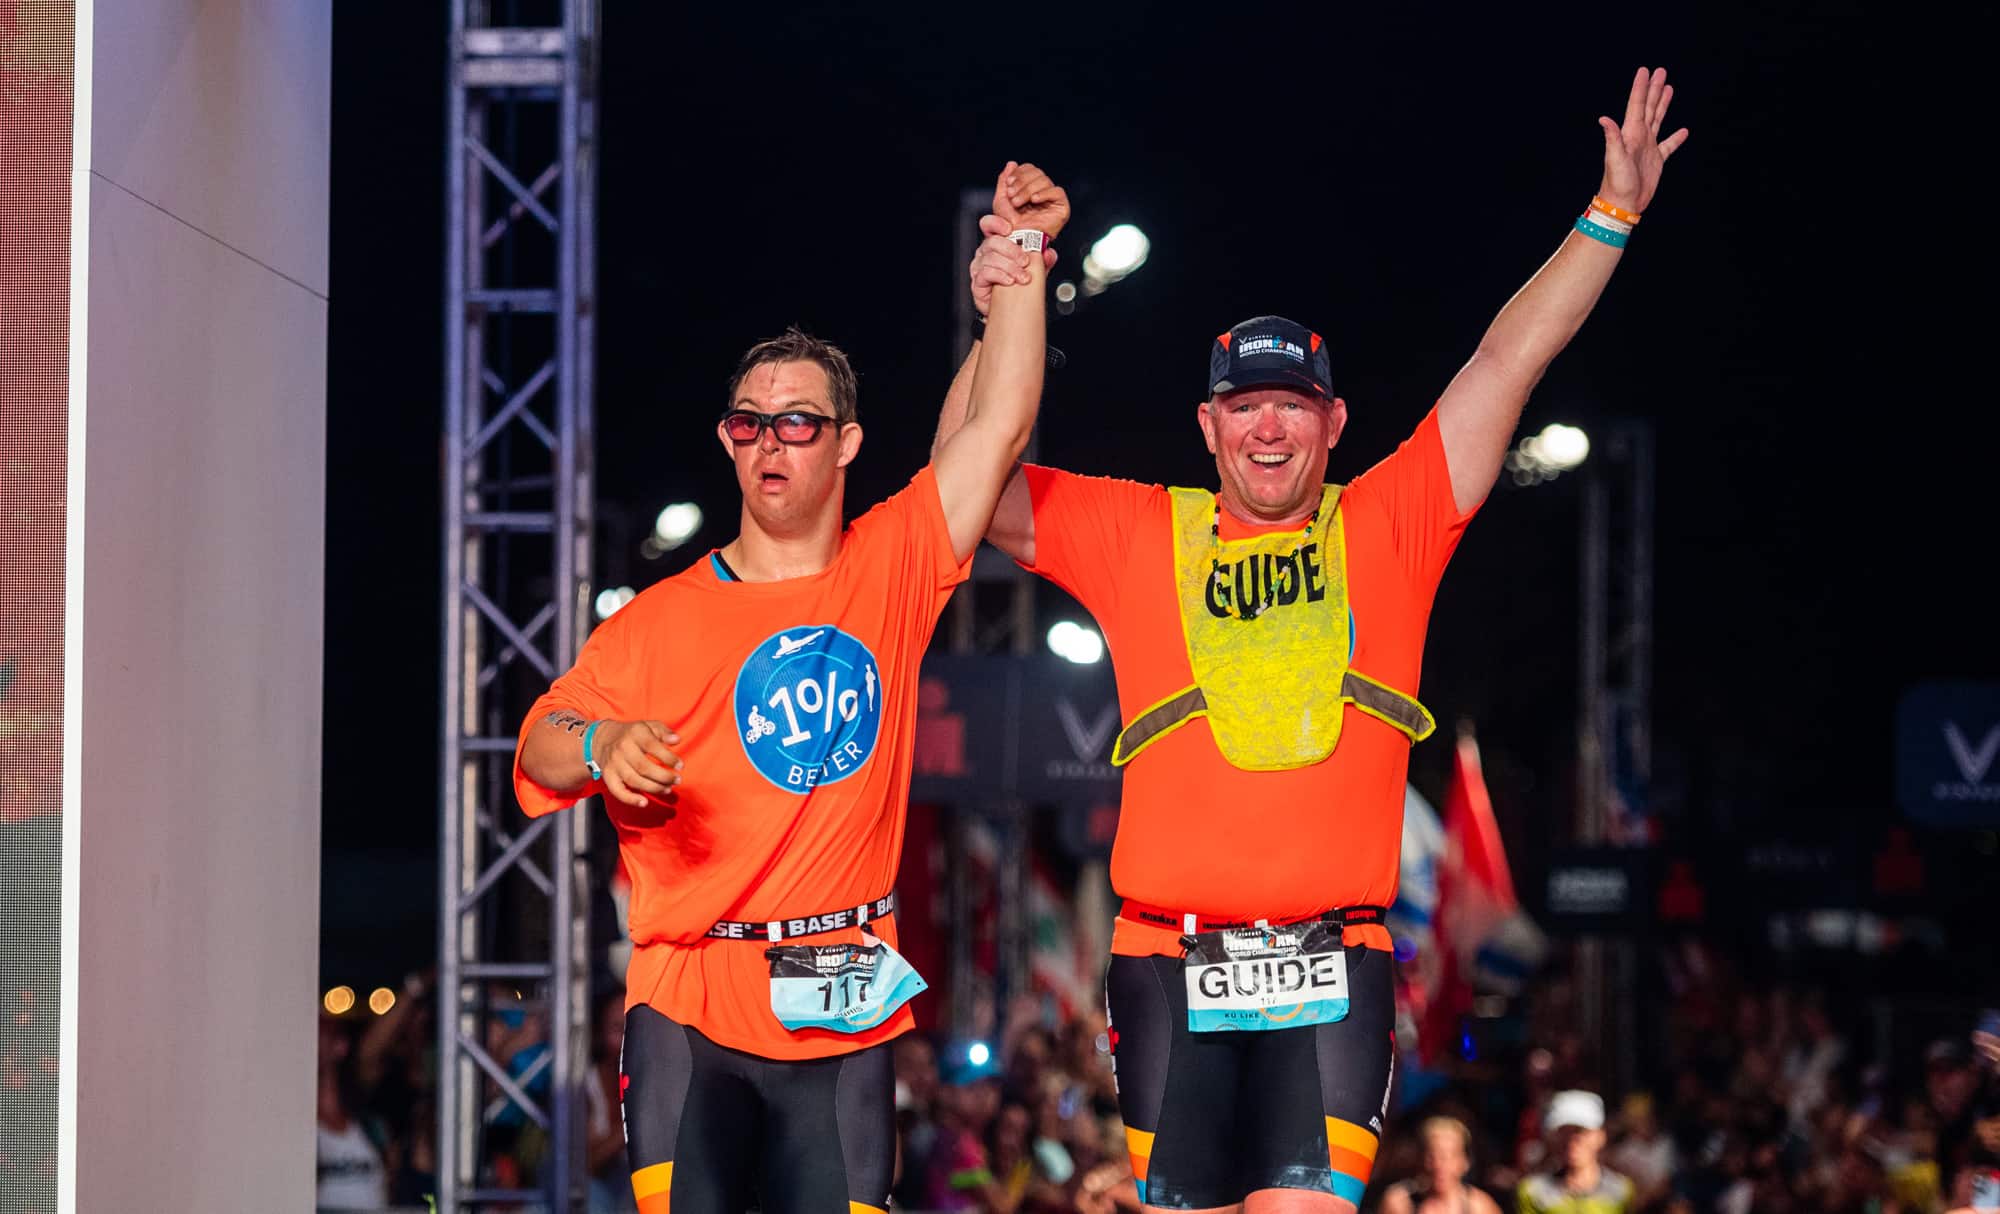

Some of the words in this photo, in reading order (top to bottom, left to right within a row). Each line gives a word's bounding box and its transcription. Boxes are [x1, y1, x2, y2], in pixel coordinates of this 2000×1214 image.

[1205, 543, 1325, 618] GUIDE
[768, 671, 859, 747] 1%
[818, 975, 873, 1012] 117
[1198, 954, 1336, 999] GUIDE
